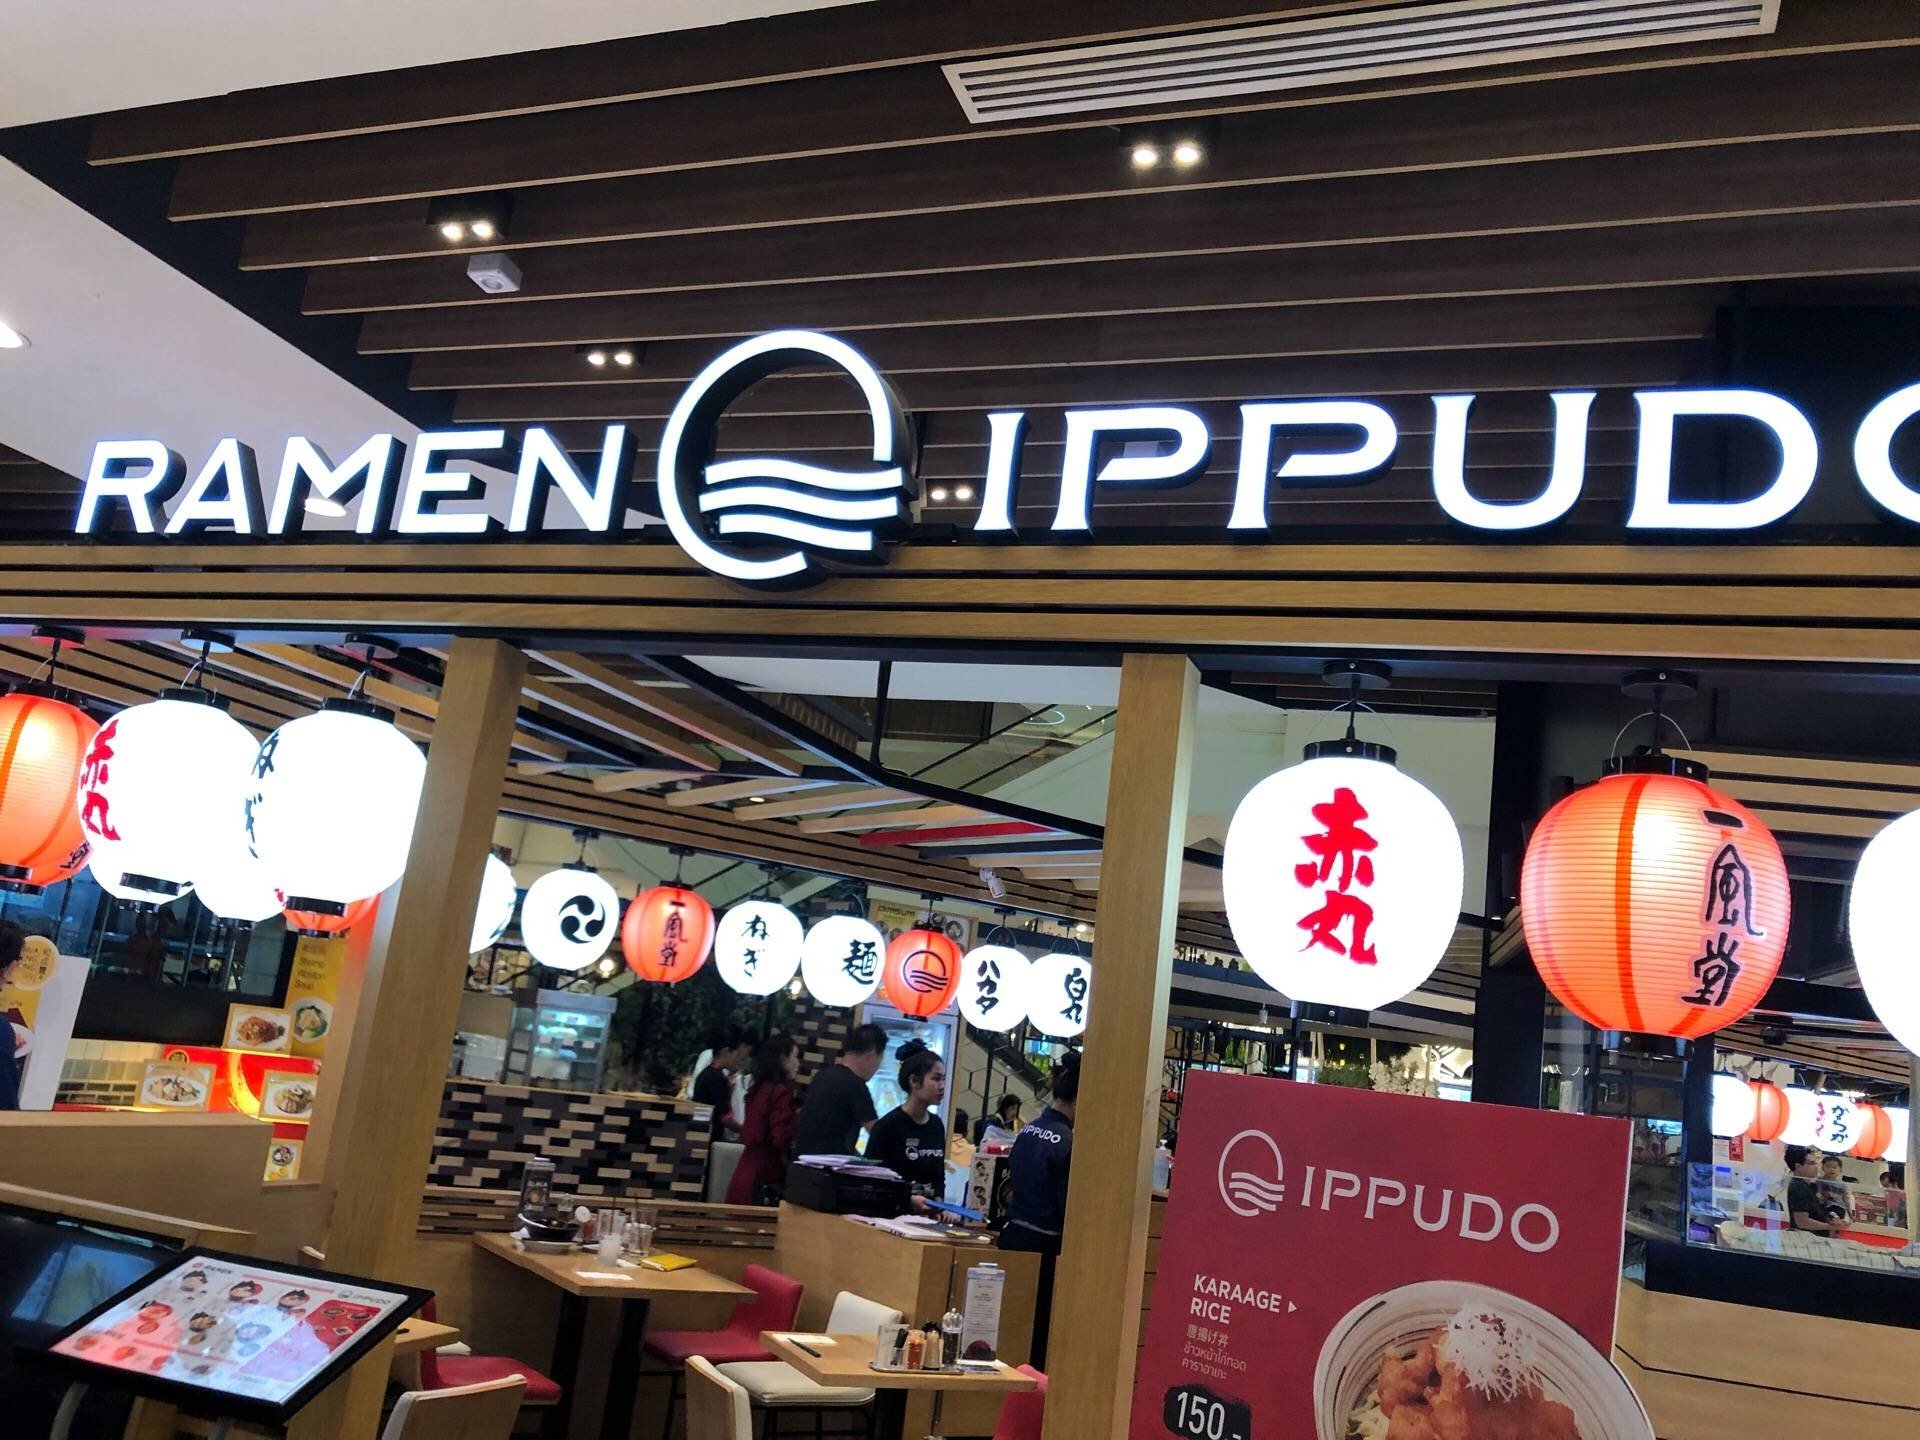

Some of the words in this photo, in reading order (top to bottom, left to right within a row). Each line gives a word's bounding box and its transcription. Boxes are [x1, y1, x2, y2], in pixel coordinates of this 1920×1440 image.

[75, 425, 626, 534] RAMEN
[1294, 787, 1379, 966] 赤丸
[1681, 808, 1765, 1008] 一風堂
[660, 900, 688, 968] 一風堂
[740, 914, 770, 978] ねぎ
[842, 939, 879, 985] 麺
[975, 959, 1001, 1016] ハカタ
[1022, 1123, 1062, 1145] IPPUDO
[1300, 1165, 1561, 1253] IPPUDO
[1190, 1297, 1232, 1324] RICE
[1194, 1274, 1282, 1313] KARAAGE
